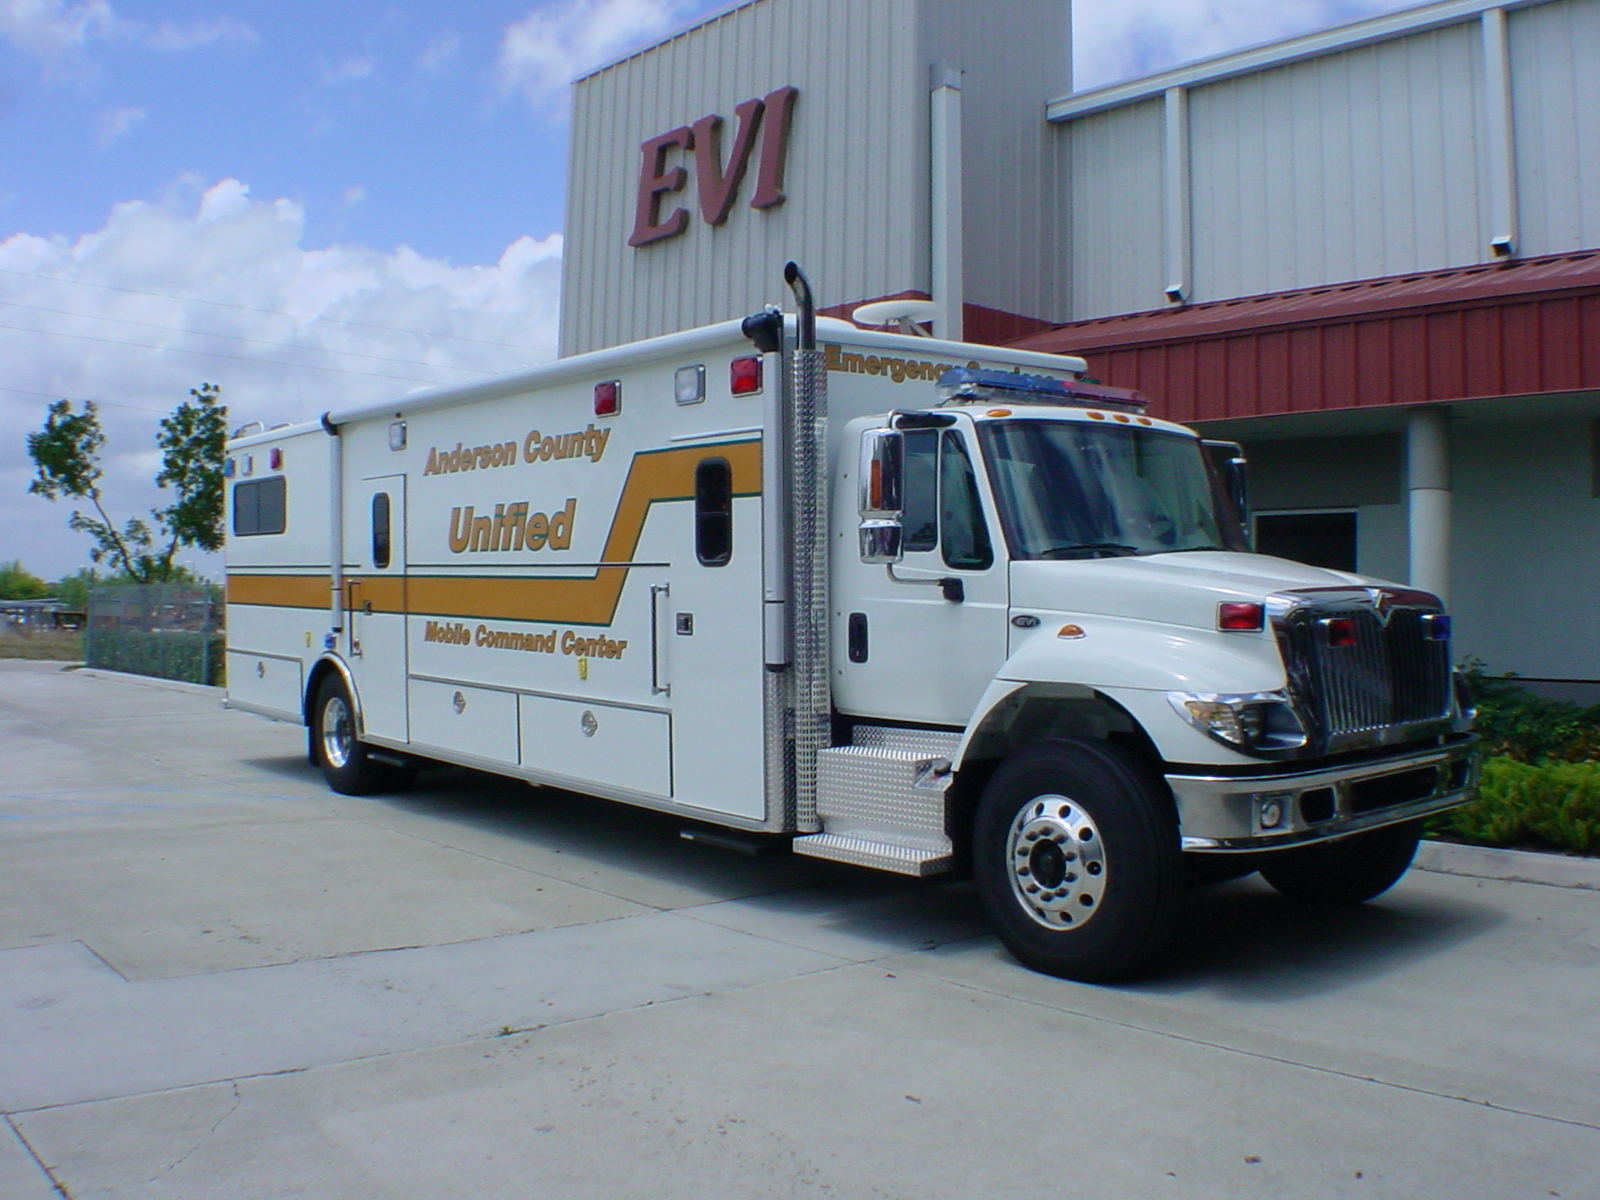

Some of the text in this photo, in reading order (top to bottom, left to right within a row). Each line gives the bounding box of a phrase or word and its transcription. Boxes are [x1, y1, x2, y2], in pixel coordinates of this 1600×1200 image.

[628, 85, 799, 247] EVI
[825, 344, 963, 383] Emergenc
[423, 423, 612, 477] Anderson County
[448, 498, 577, 553] Unified
[424, 620, 628, 660] Mobile Command Center
